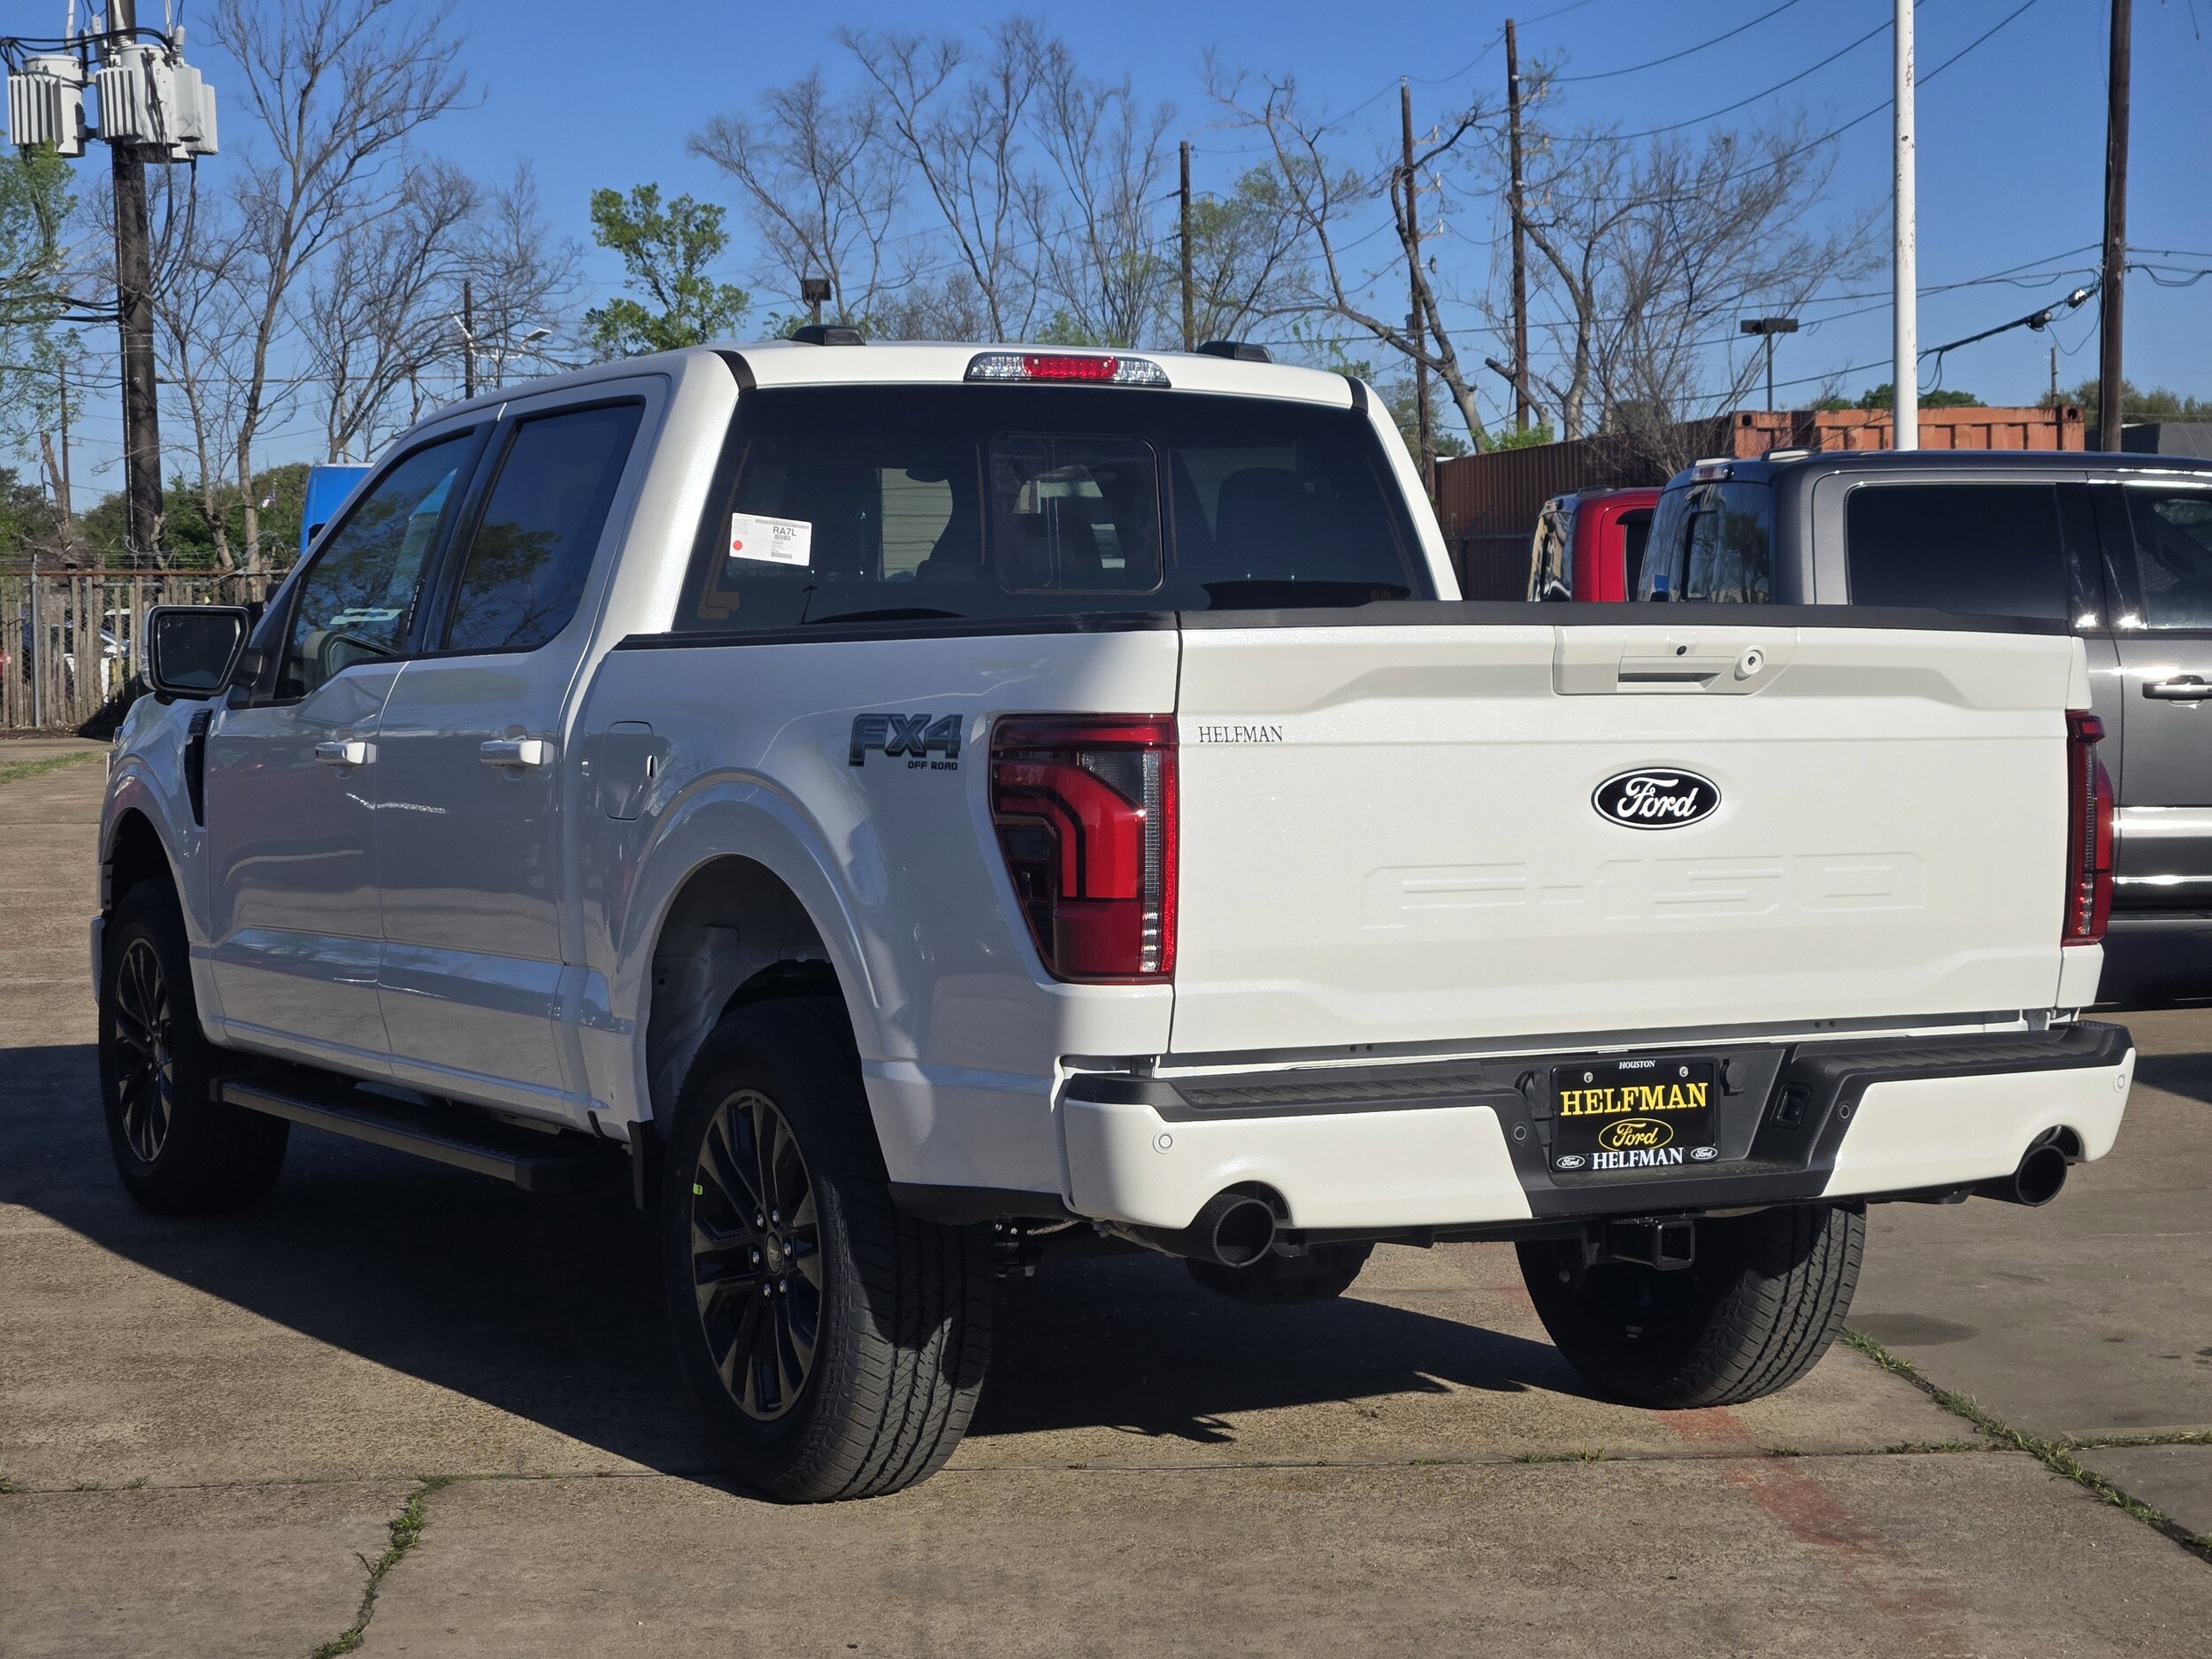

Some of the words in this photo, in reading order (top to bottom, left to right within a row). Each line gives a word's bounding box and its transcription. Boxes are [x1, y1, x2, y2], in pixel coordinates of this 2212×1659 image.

[772, 526, 797, 537] RA7L
[849, 713, 964, 766] FX4
[1198, 726, 1283, 742] HELFMAN
[907, 760, 928, 770] OFF
[931, 761, 958, 771] ROAD
[1617, 777, 1700, 818] Ford
[1618, 1060, 1656, 1070] HOUSTON
[1560, 1082, 1709, 1117] HELFMAN
[1612, 1122, 1659, 1147] Ford
[1593, 1147, 1685, 1170] HELFMAN
